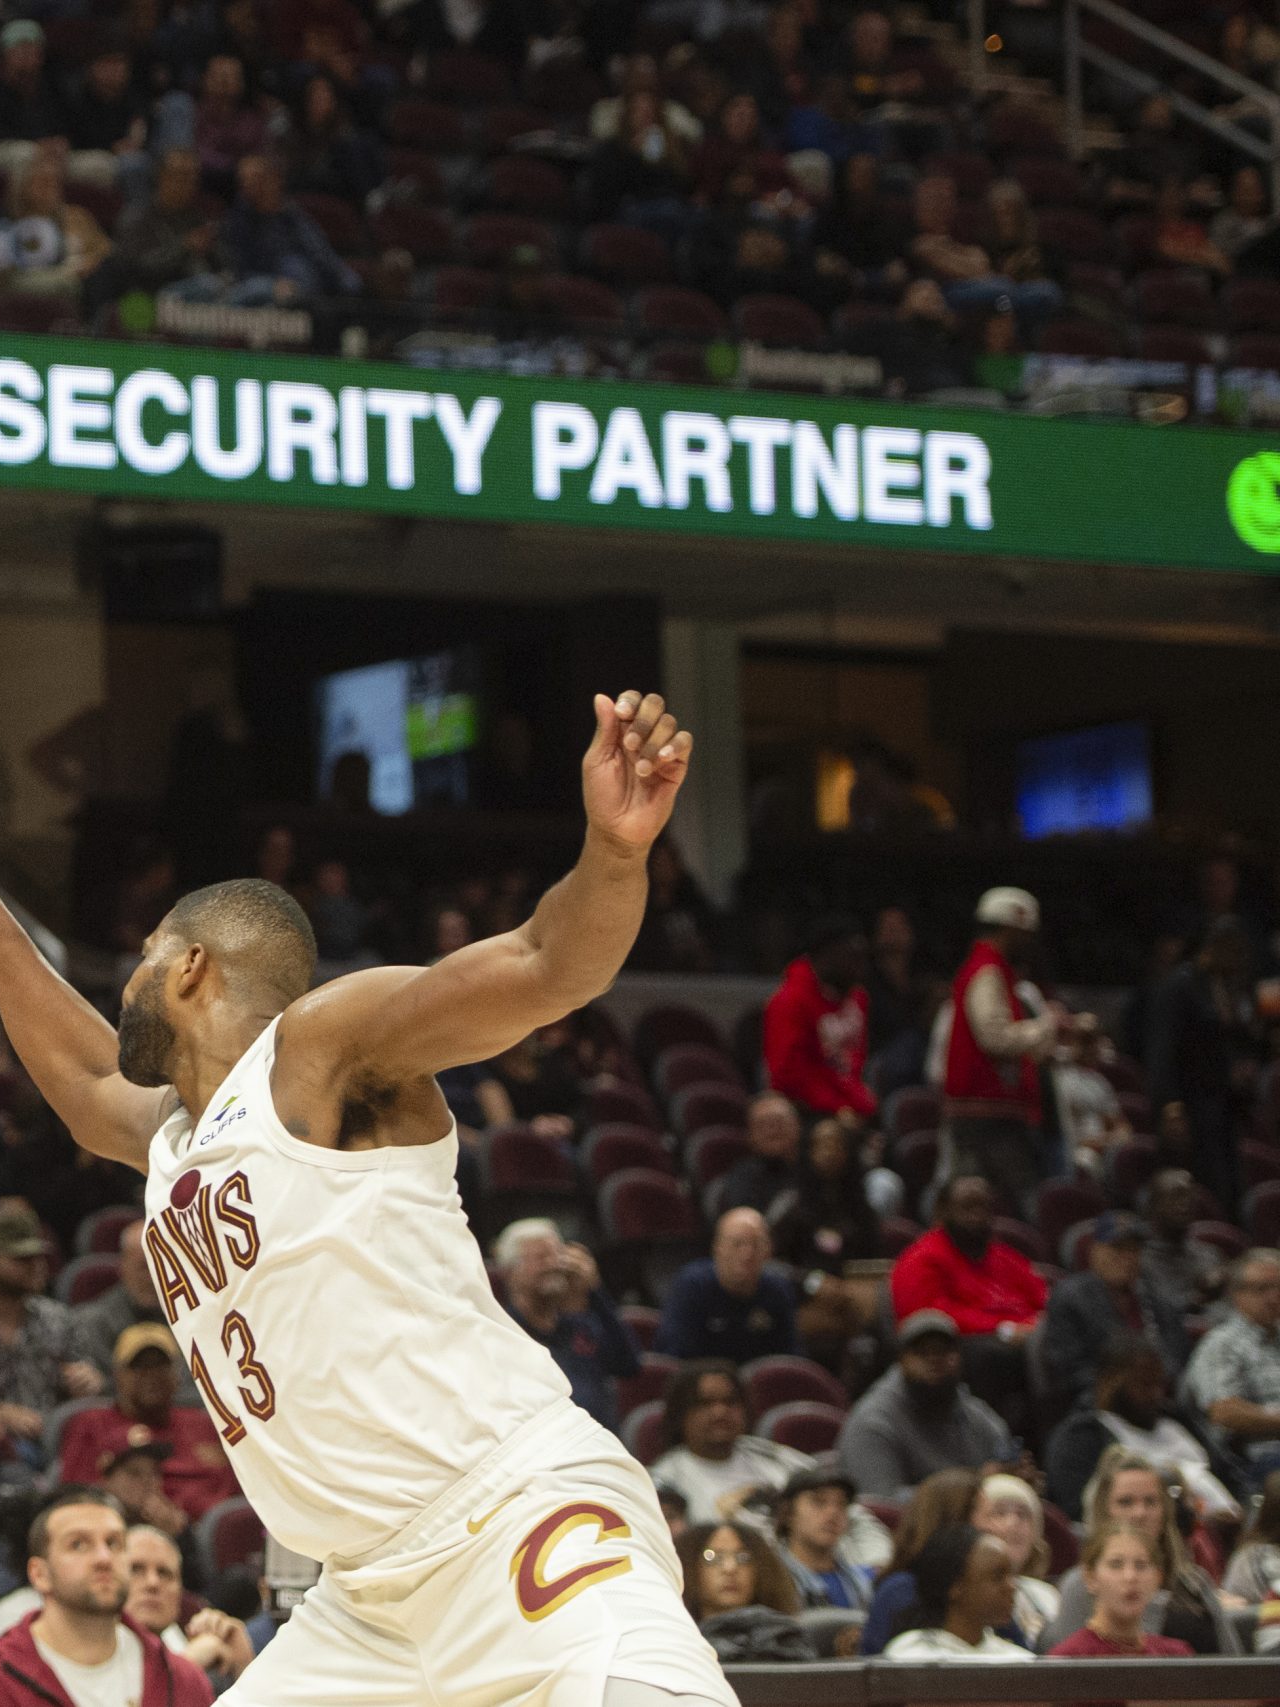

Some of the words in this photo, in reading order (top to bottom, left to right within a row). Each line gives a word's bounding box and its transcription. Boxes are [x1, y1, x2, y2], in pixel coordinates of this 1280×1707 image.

[532, 399, 994, 530] PARTNER
[199, 1107, 247, 1146] CLIFFS
[145, 1169, 261, 1326] AVS
[191, 1309, 276, 1447] 13
